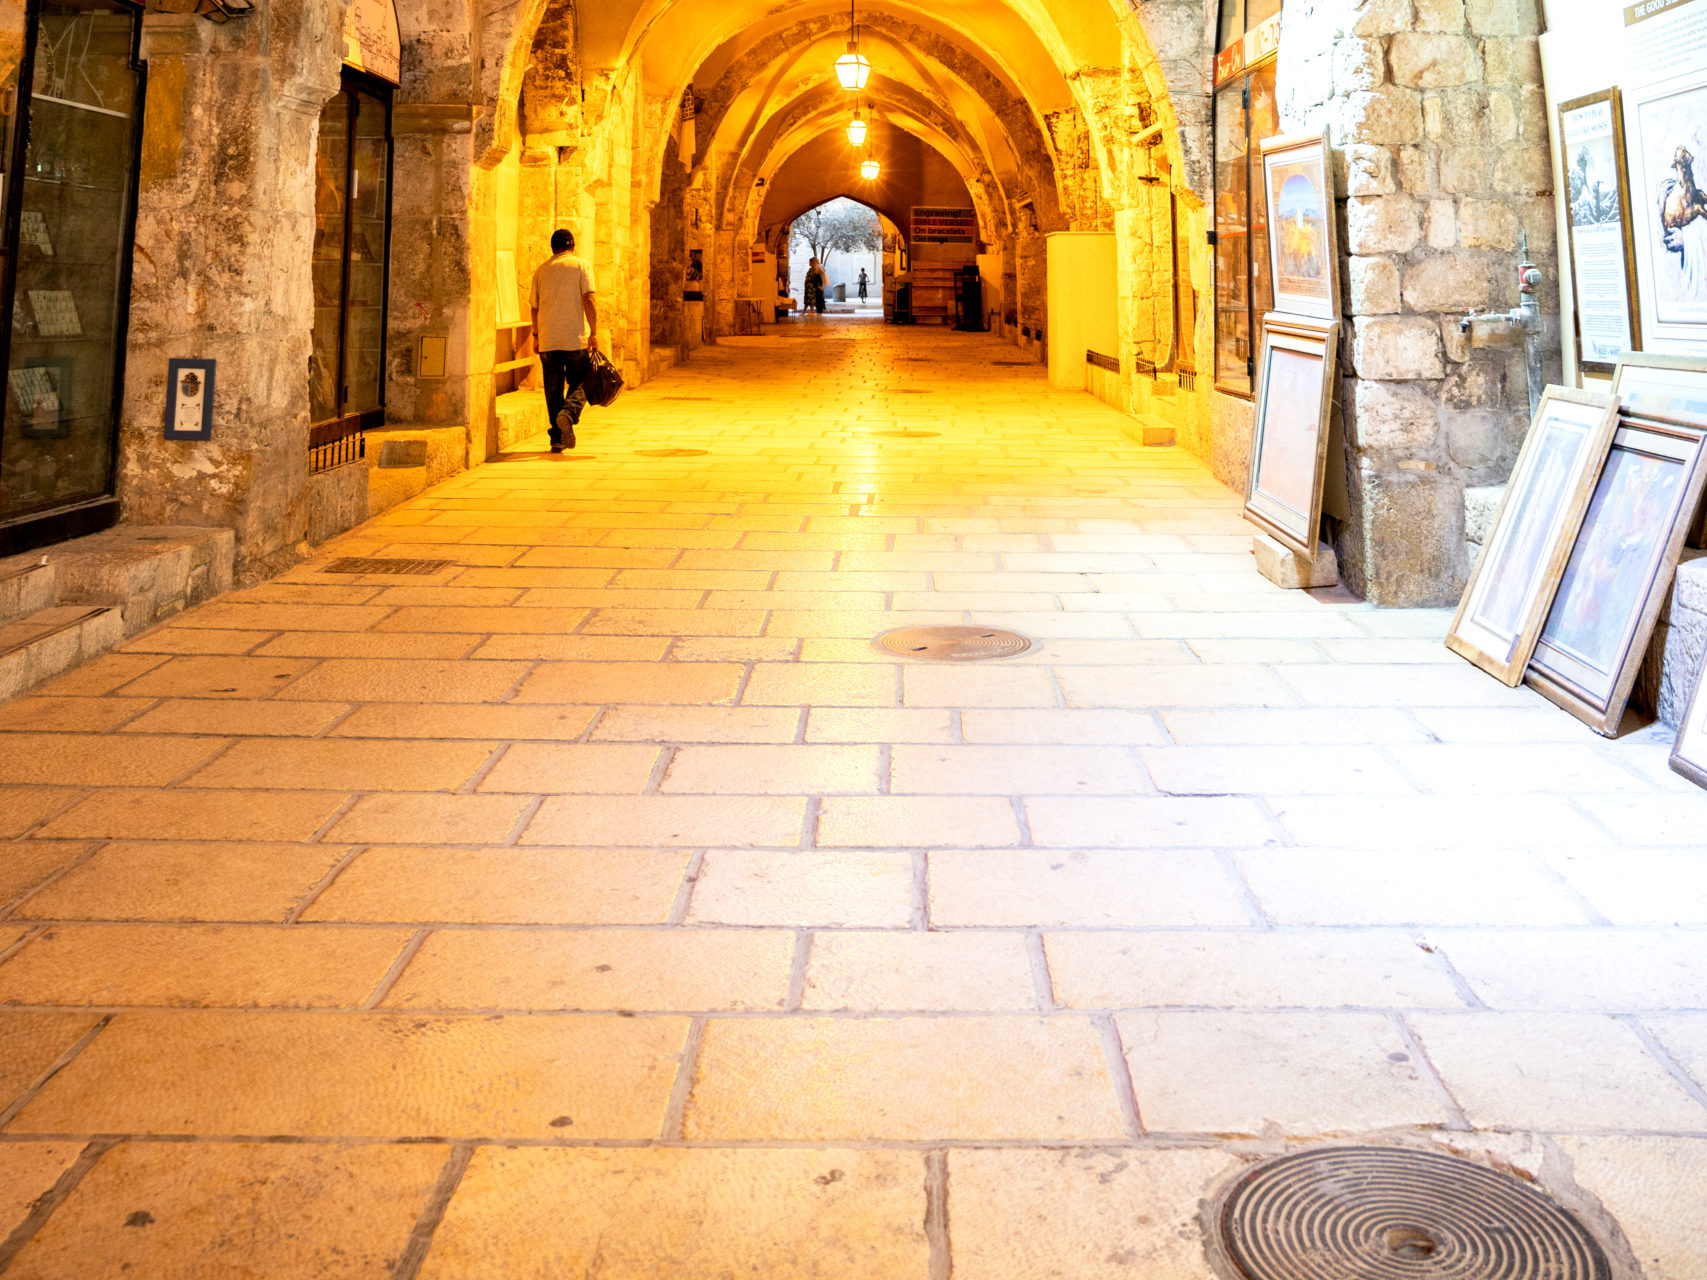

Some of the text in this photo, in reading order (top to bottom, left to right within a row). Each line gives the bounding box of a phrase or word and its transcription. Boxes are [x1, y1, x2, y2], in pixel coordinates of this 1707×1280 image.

[1634, 5, 1646, 18] THE
[914, 209, 961, 218] Engraving!
[914, 218, 937, 226] BIBLE
[913, 226, 966, 235] On bracelets
[928, 236, 949, 244] rings
